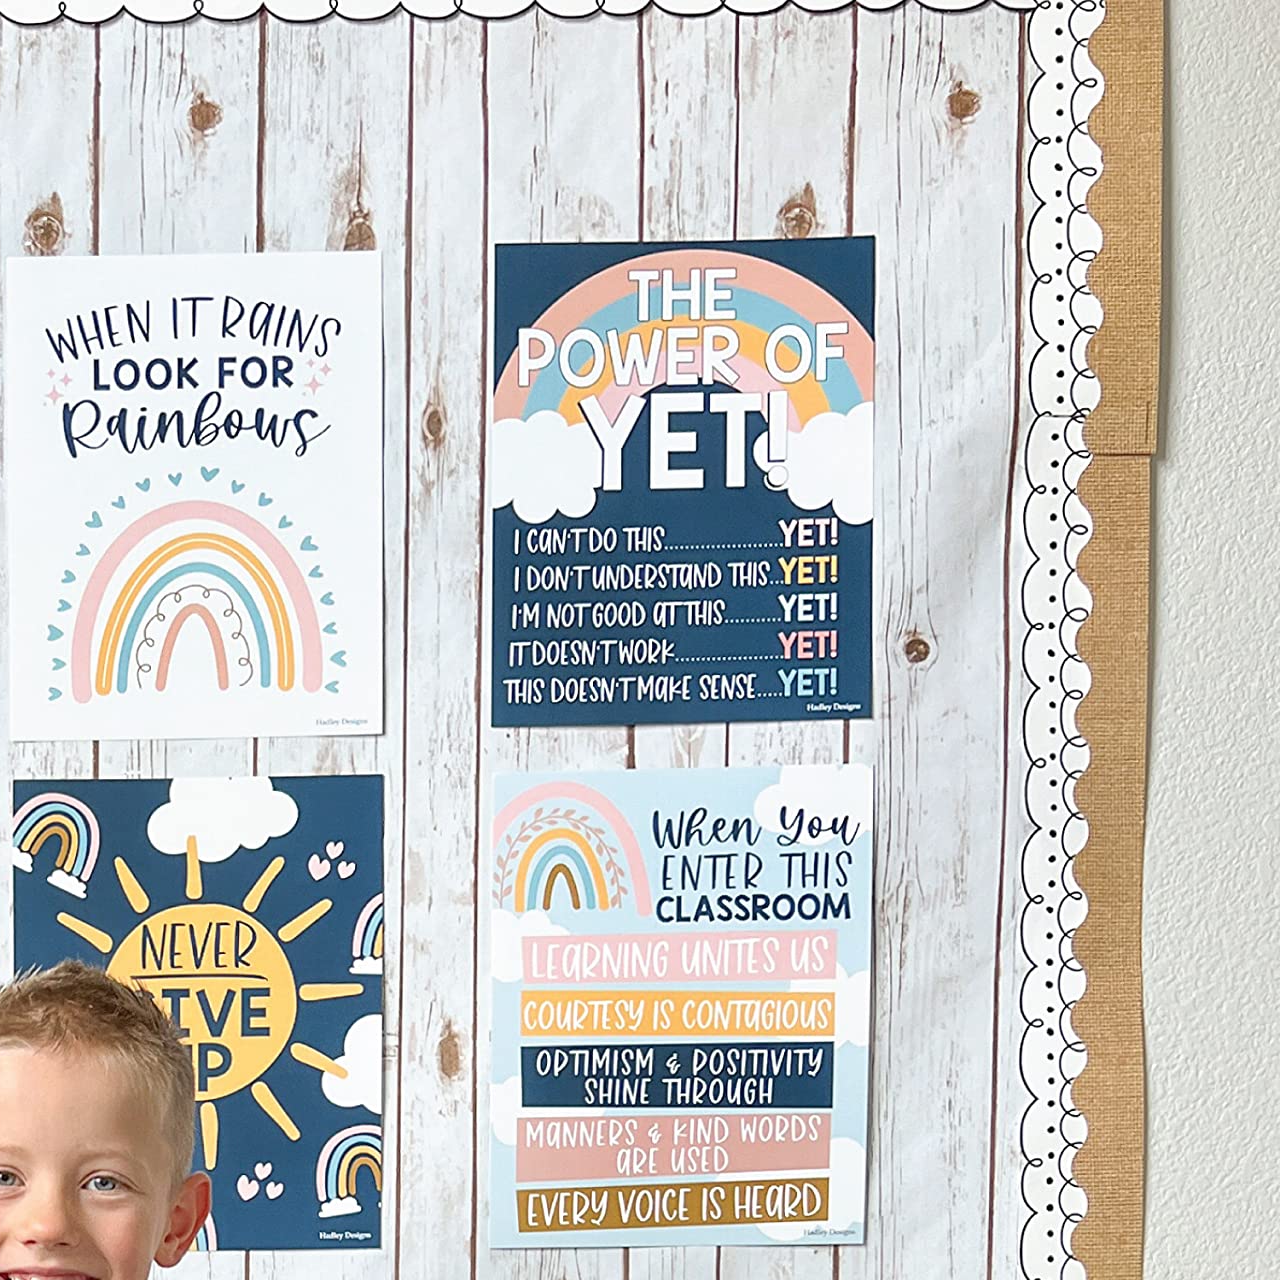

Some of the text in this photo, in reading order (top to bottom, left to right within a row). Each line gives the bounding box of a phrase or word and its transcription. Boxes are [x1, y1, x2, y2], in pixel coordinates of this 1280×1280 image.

[629, 268, 737, 321] THE
[94, 356, 294, 391] LOOK FOR
[518, 322, 848, 388] POWER OF
[62, 391, 331, 458] Rainbows
[578, 390, 789, 491] YET!
[778, 556, 837, 585] YET!
[652, 806, 860, 849] When You
[662, 851, 853, 891] ENTER THIS
[656, 893, 851, 922] CLASSROOM
[141, 920, 257, 971] NEVER
[536, 1049, 653, 1076] OPTIMISM
[693, 1049, 822, 1076] POSITIVITY
[584, 1078, 773, 1104] SHINE THROUGH
[528, 1188, 690, 1227] EVERY VOICE
